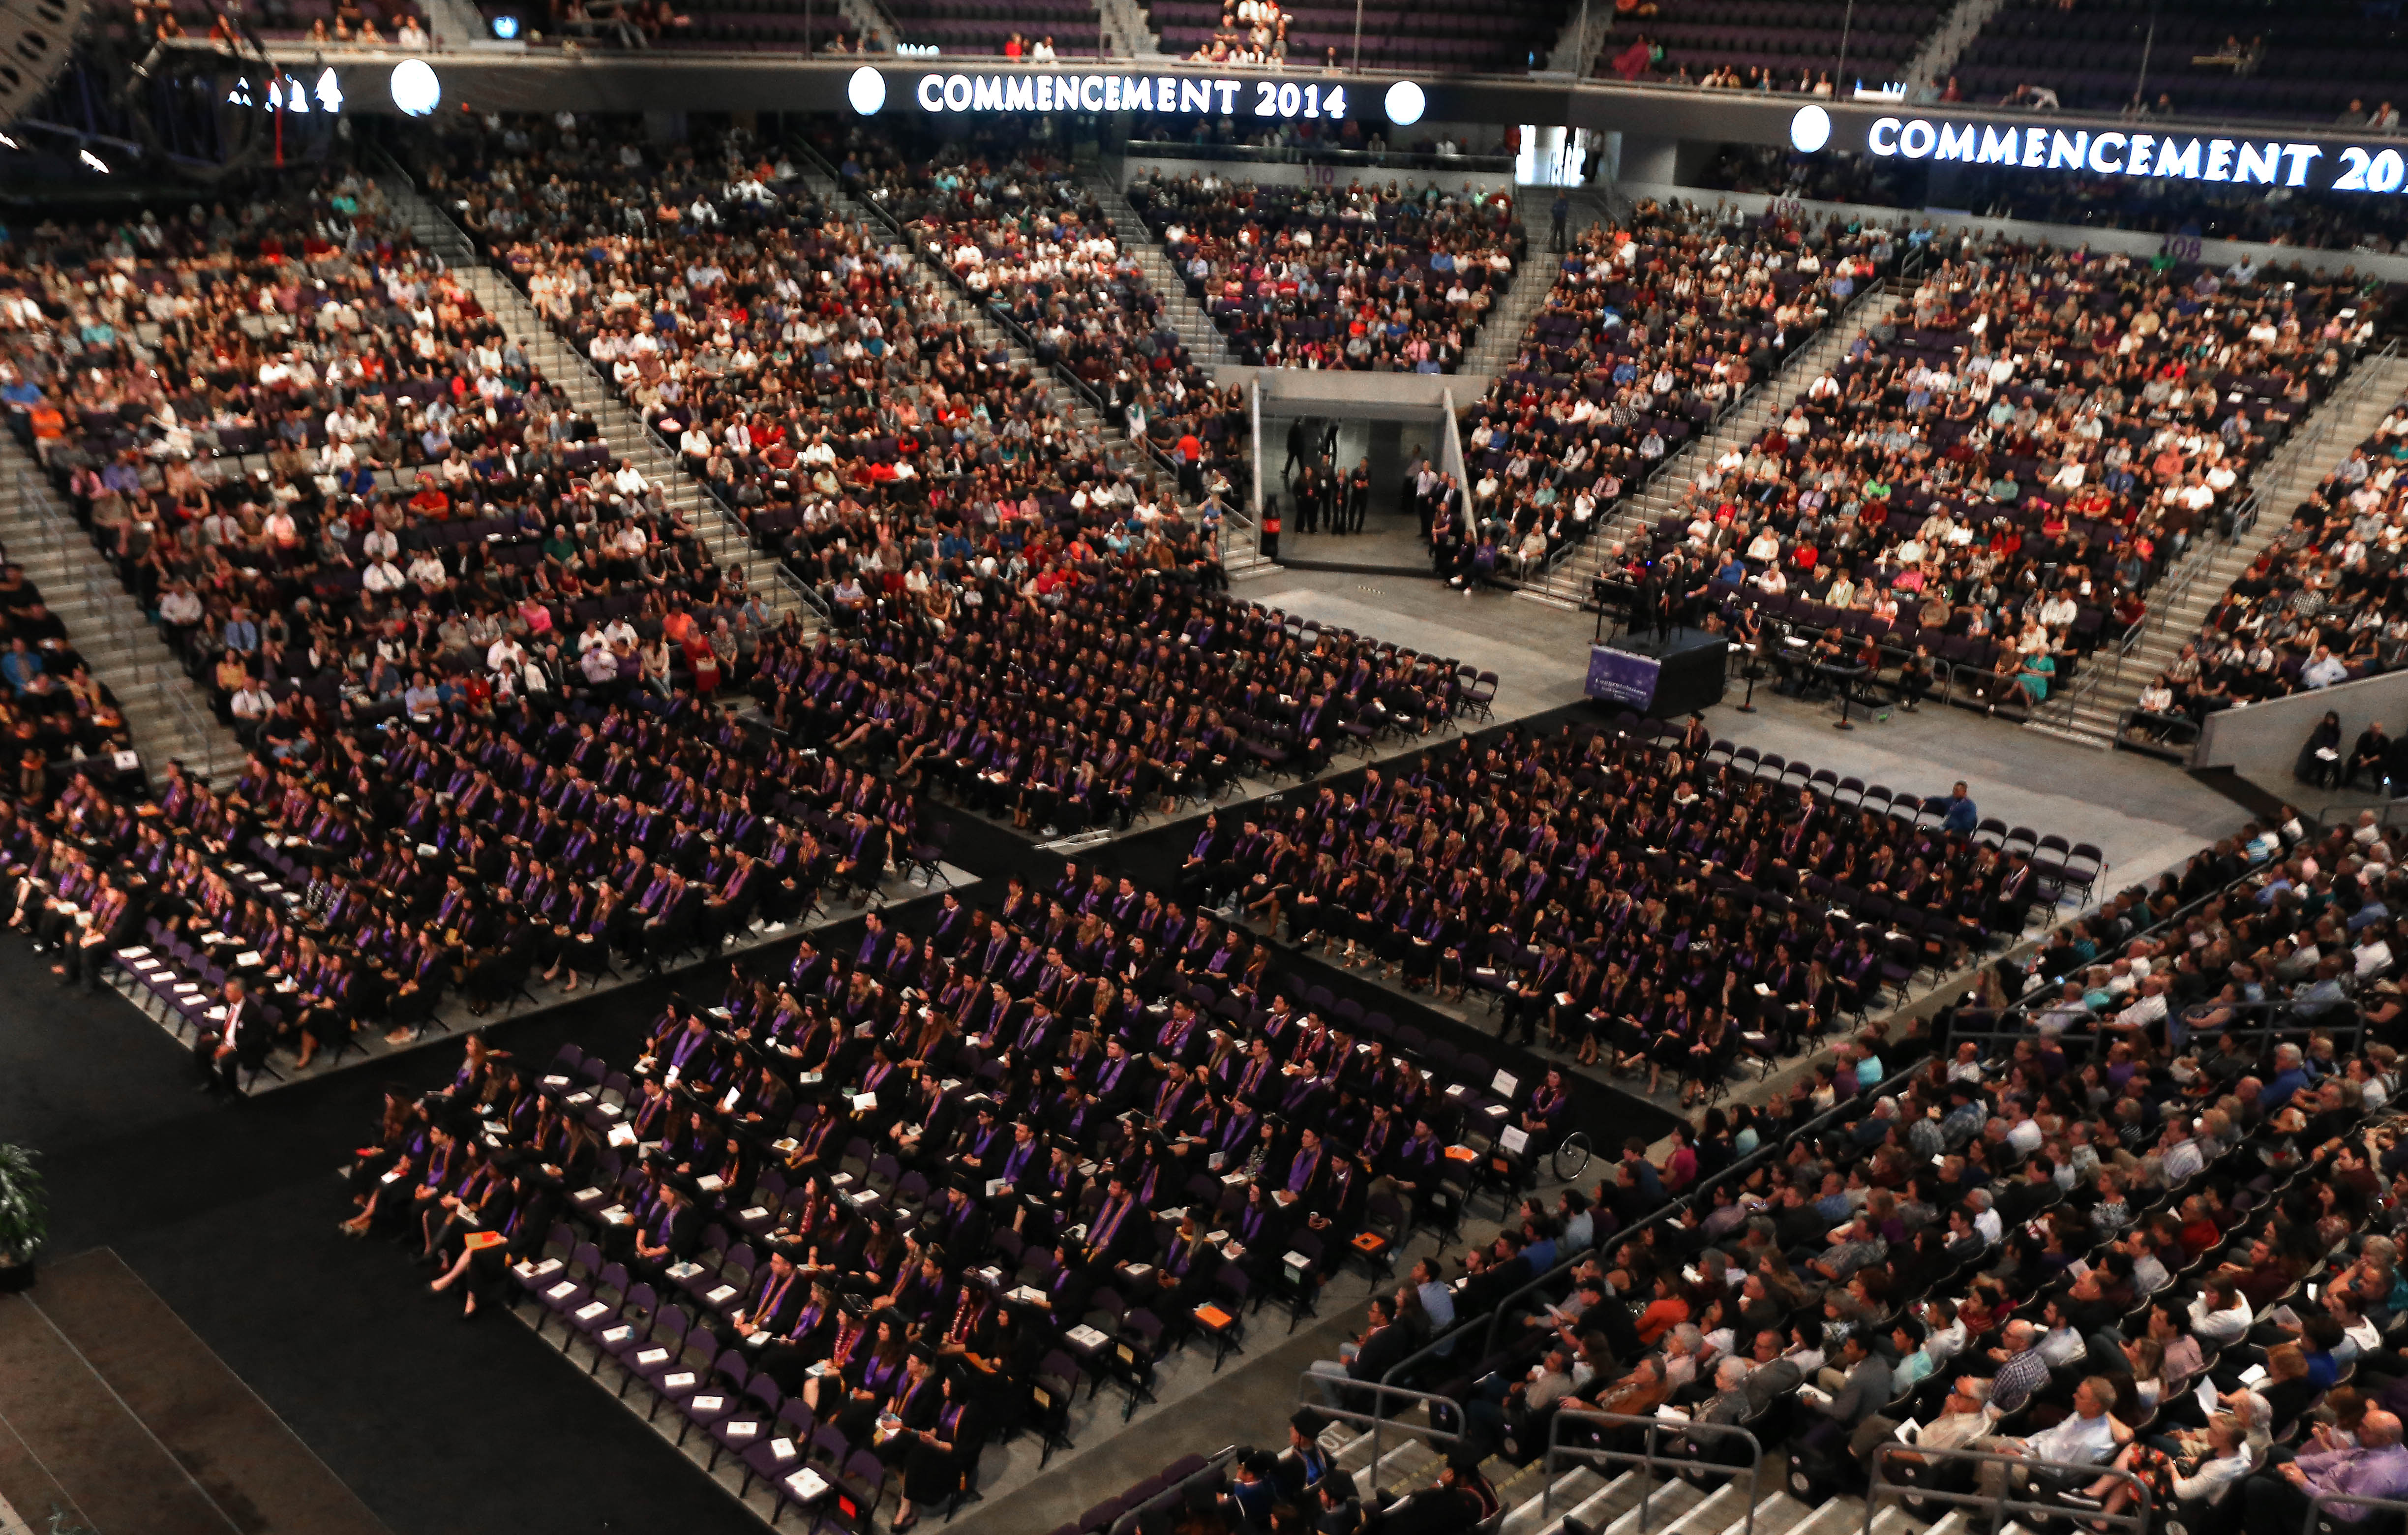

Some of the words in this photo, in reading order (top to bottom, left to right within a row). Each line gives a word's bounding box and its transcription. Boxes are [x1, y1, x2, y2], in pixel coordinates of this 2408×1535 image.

[918, 74, 1242, 114] COMMENCEMENT
[1254, 81, 1347, 119] 2014
[1869, 118, 2323, 186] COMMENCEMENT
[2331, 147, 2408, 193] 20
